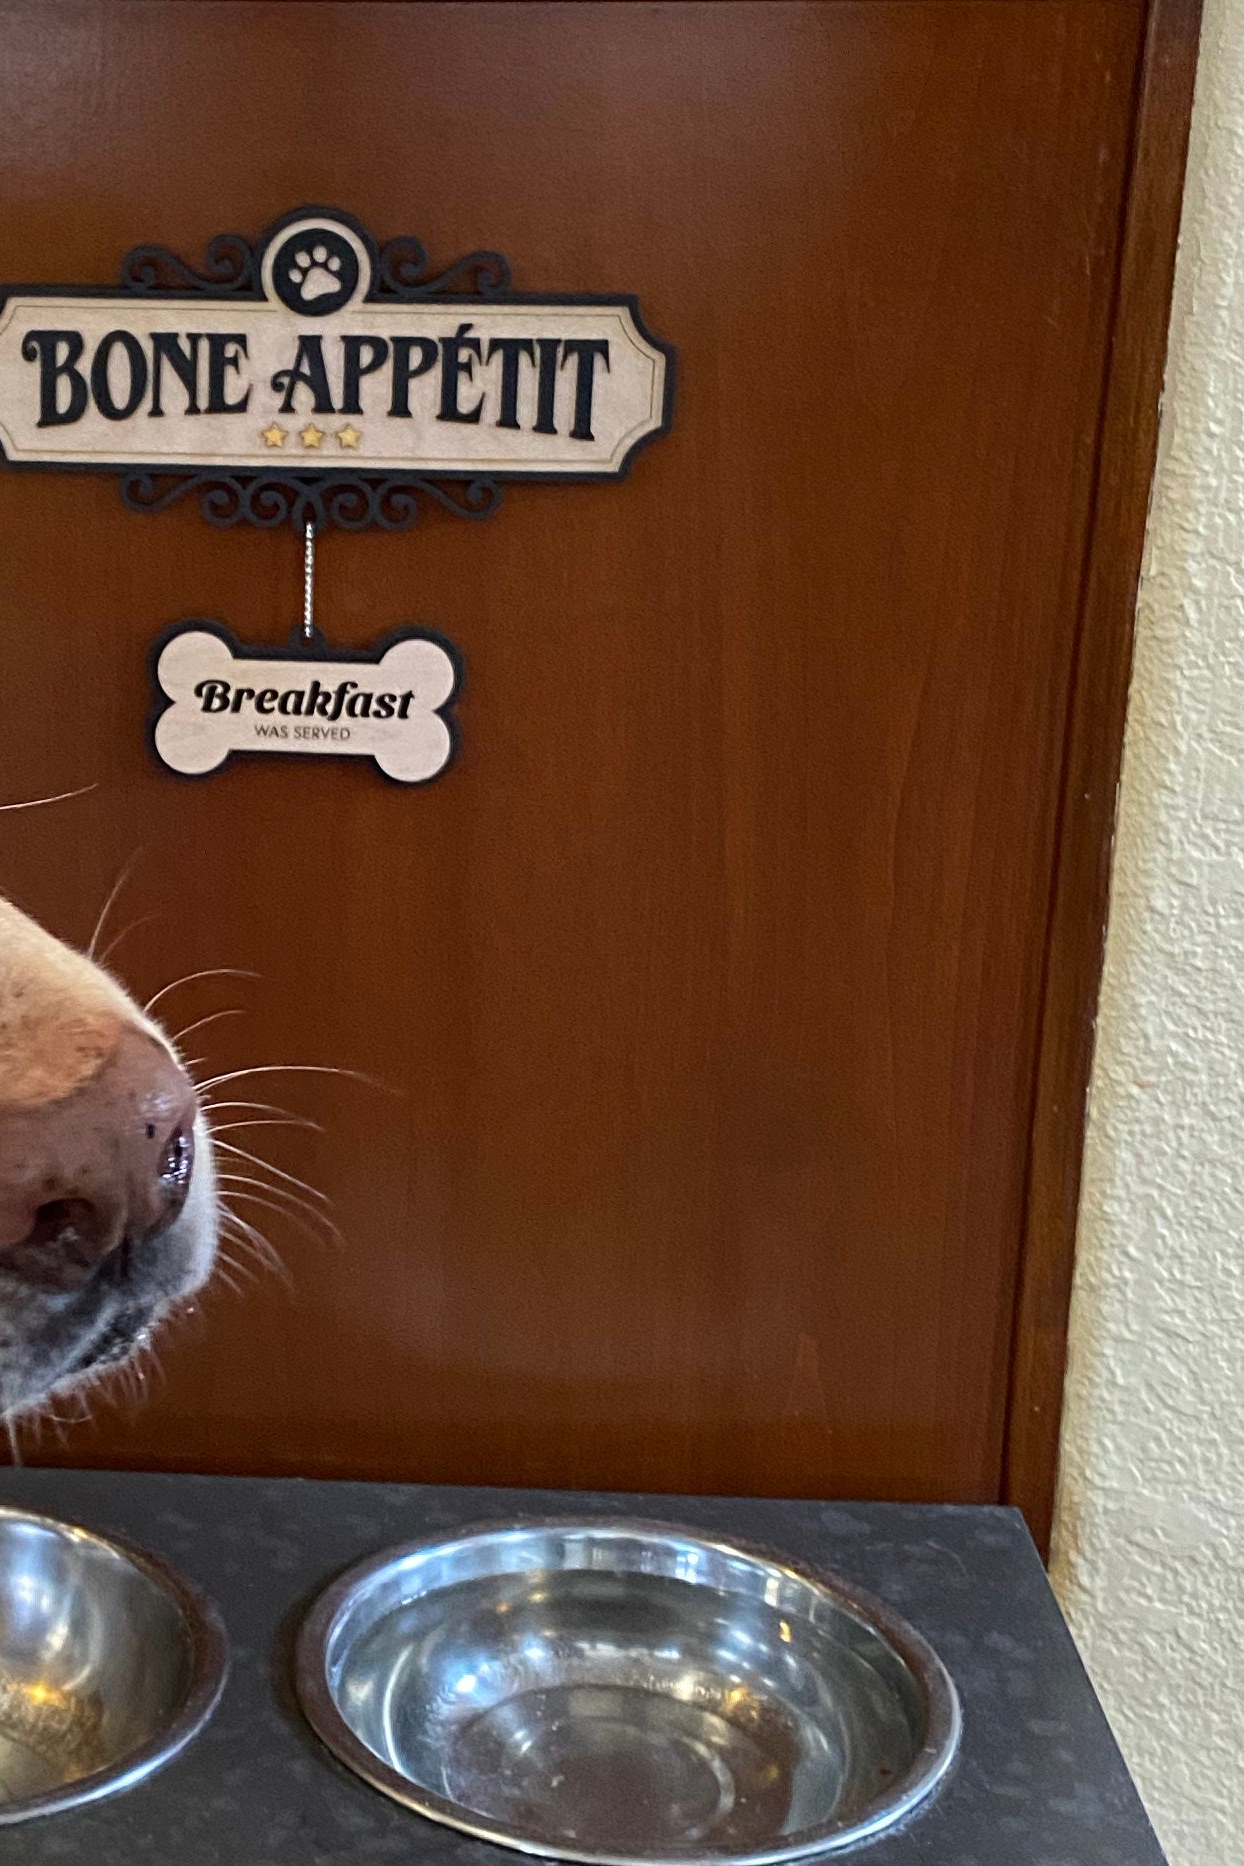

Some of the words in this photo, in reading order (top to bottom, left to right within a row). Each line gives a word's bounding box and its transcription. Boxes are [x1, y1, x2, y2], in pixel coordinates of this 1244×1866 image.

[21, 329, 253, 428] BONE
[270, 323, 611, 442] APPÉTIT
[194, 679, 415, 721] Breakfast
[254, 723, 288, 739] WAS
[294, 725, 351, 741] SERVED
